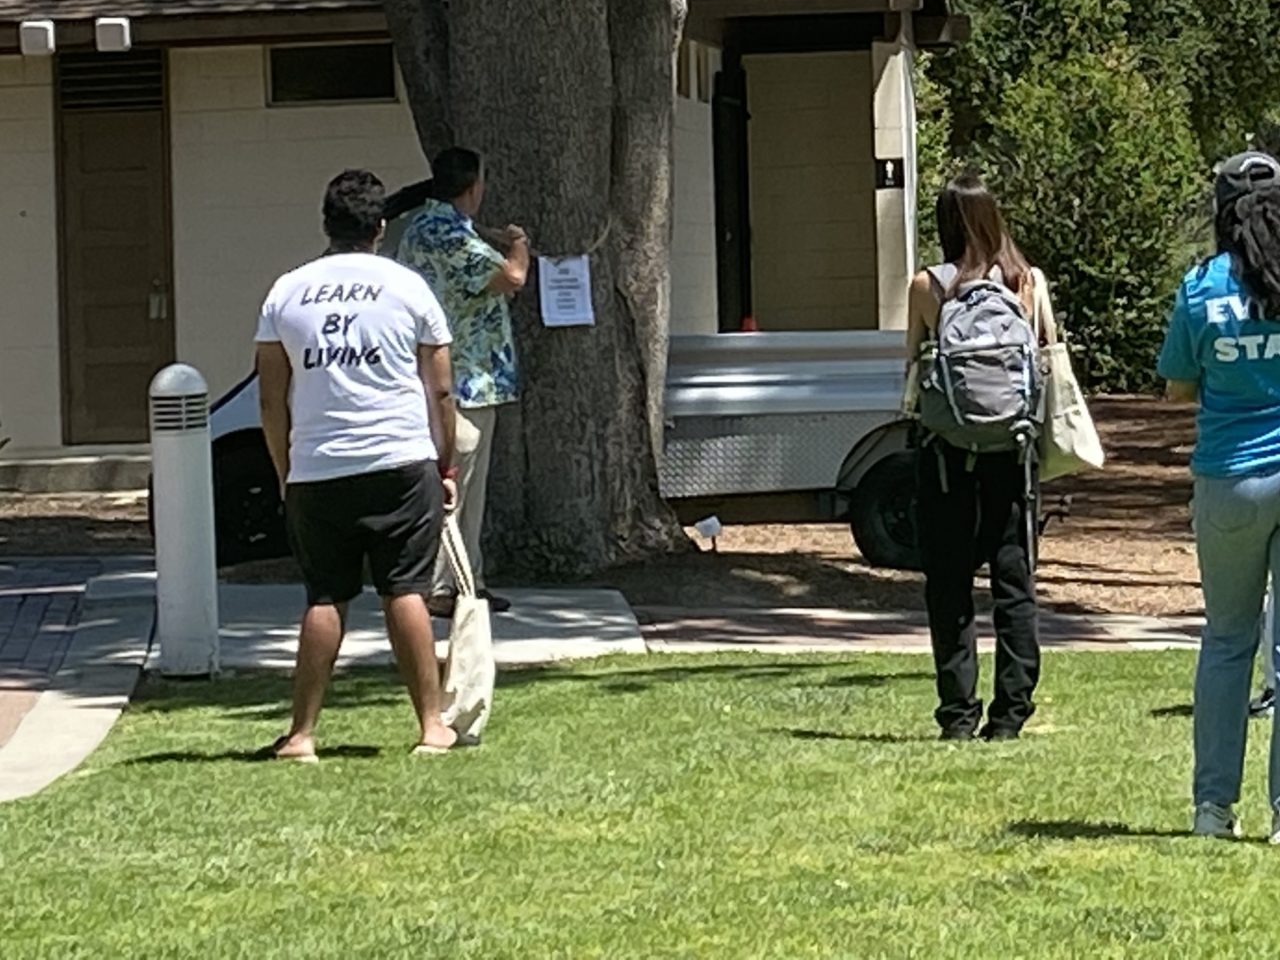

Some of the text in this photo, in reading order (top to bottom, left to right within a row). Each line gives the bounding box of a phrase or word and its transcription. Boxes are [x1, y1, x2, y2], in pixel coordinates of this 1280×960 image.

[301, 284, 382, 306] LEARN
[322, 313, 358, 336] BY
[303, 347, 381, 370] LIVING
